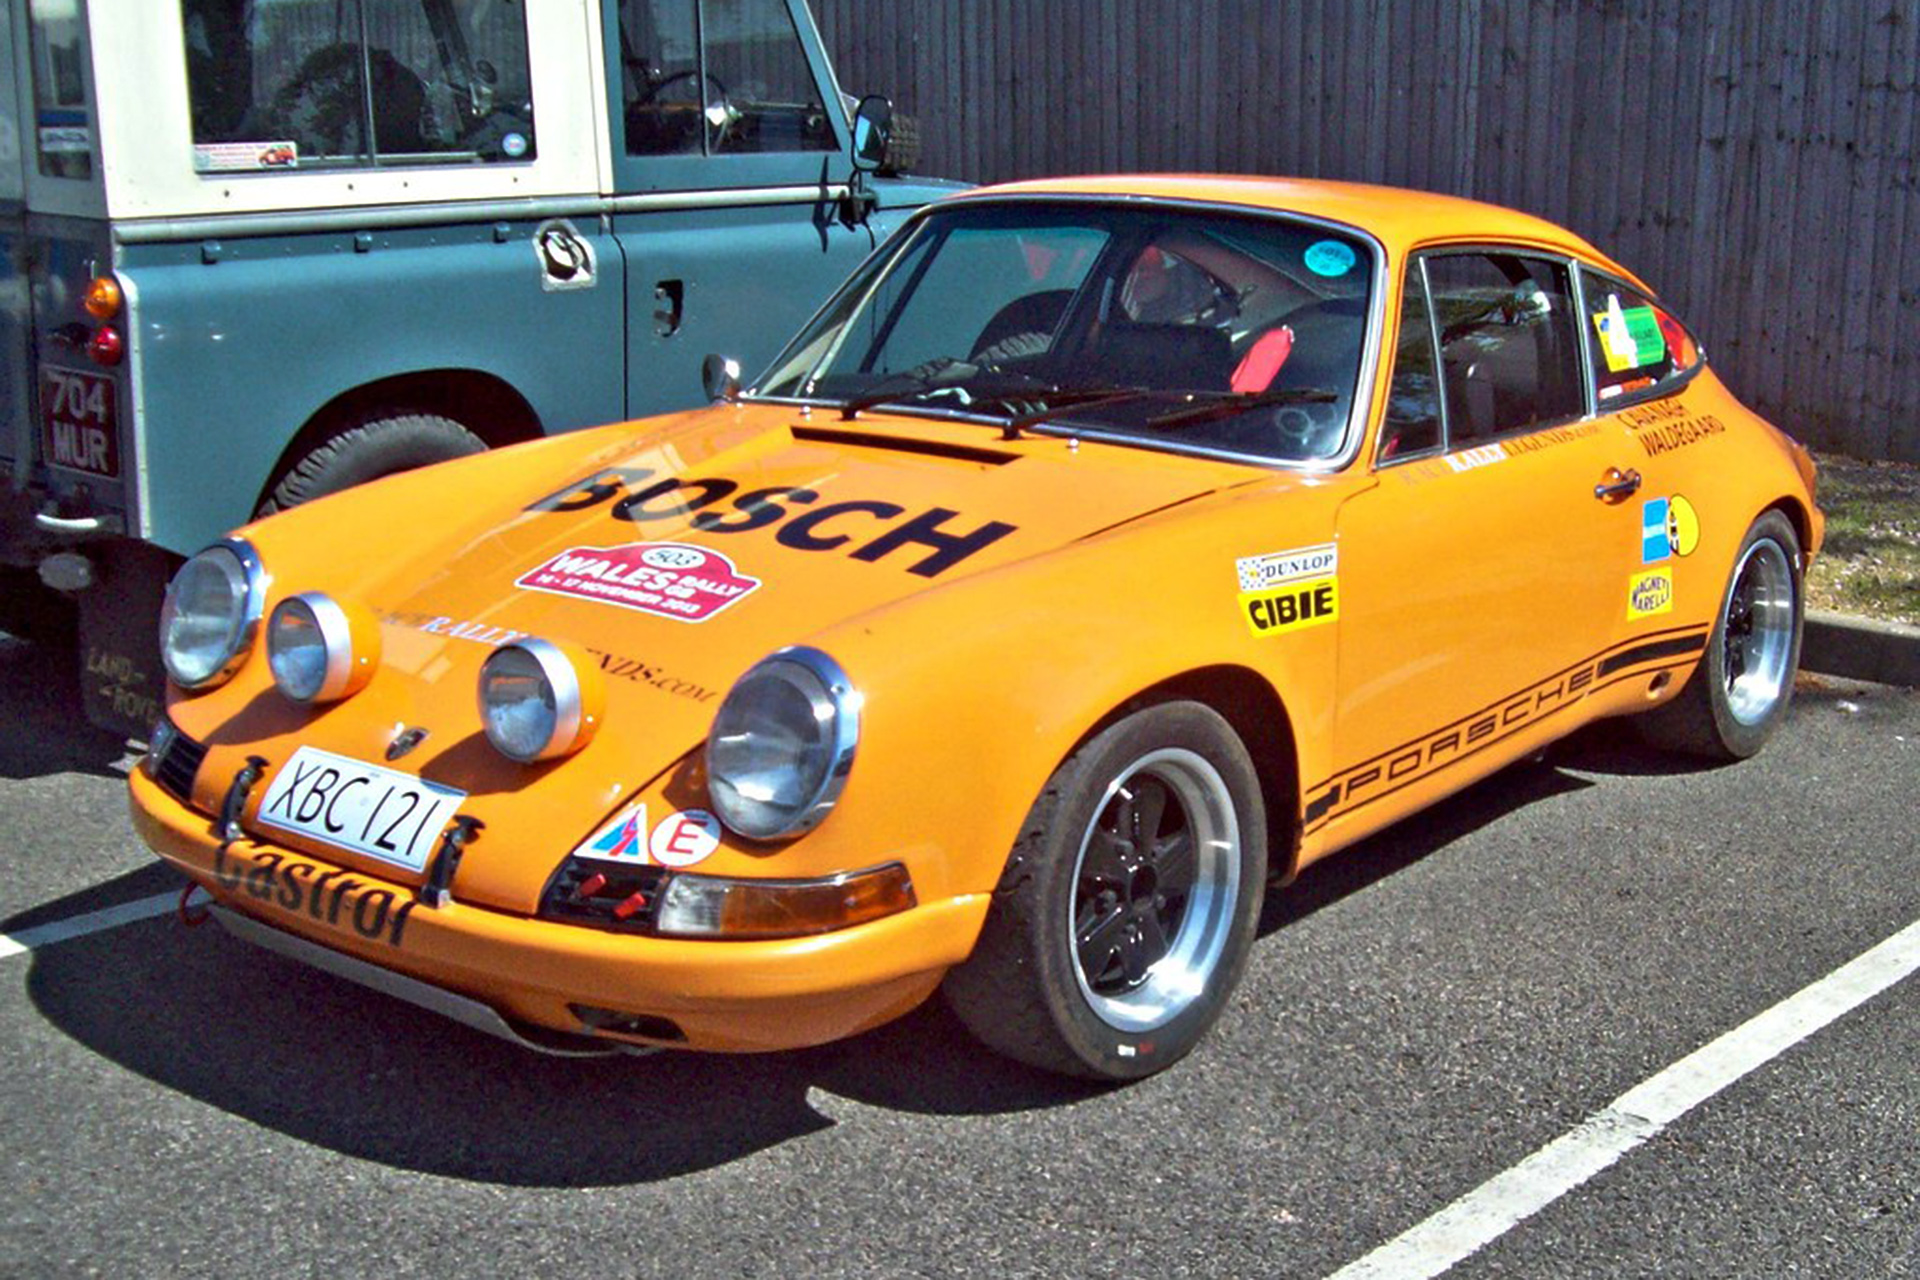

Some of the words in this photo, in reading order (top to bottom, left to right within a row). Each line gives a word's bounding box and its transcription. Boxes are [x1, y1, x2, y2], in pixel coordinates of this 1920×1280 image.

[46, 369, 106, 423] 704
[54, 421, 108, 473] MUR
[522, 466, 1019, 578] BOSCH
[550, 555, 678, 590] WALES
[678, 575, 744, 597] RALLY
[649, 548, 697, 566] 503
[1265, 554, 1333, 578] DUNLOP
[420, 615, 529, 646] RALLY
[1345, 665, 1594, 801] PORSCHE
[268, 760, 370, 834] XBC
[360, 785, 441, 857] 121
[666, 819, 708, 855] E
[214, 842, 418, 946] Castrol
